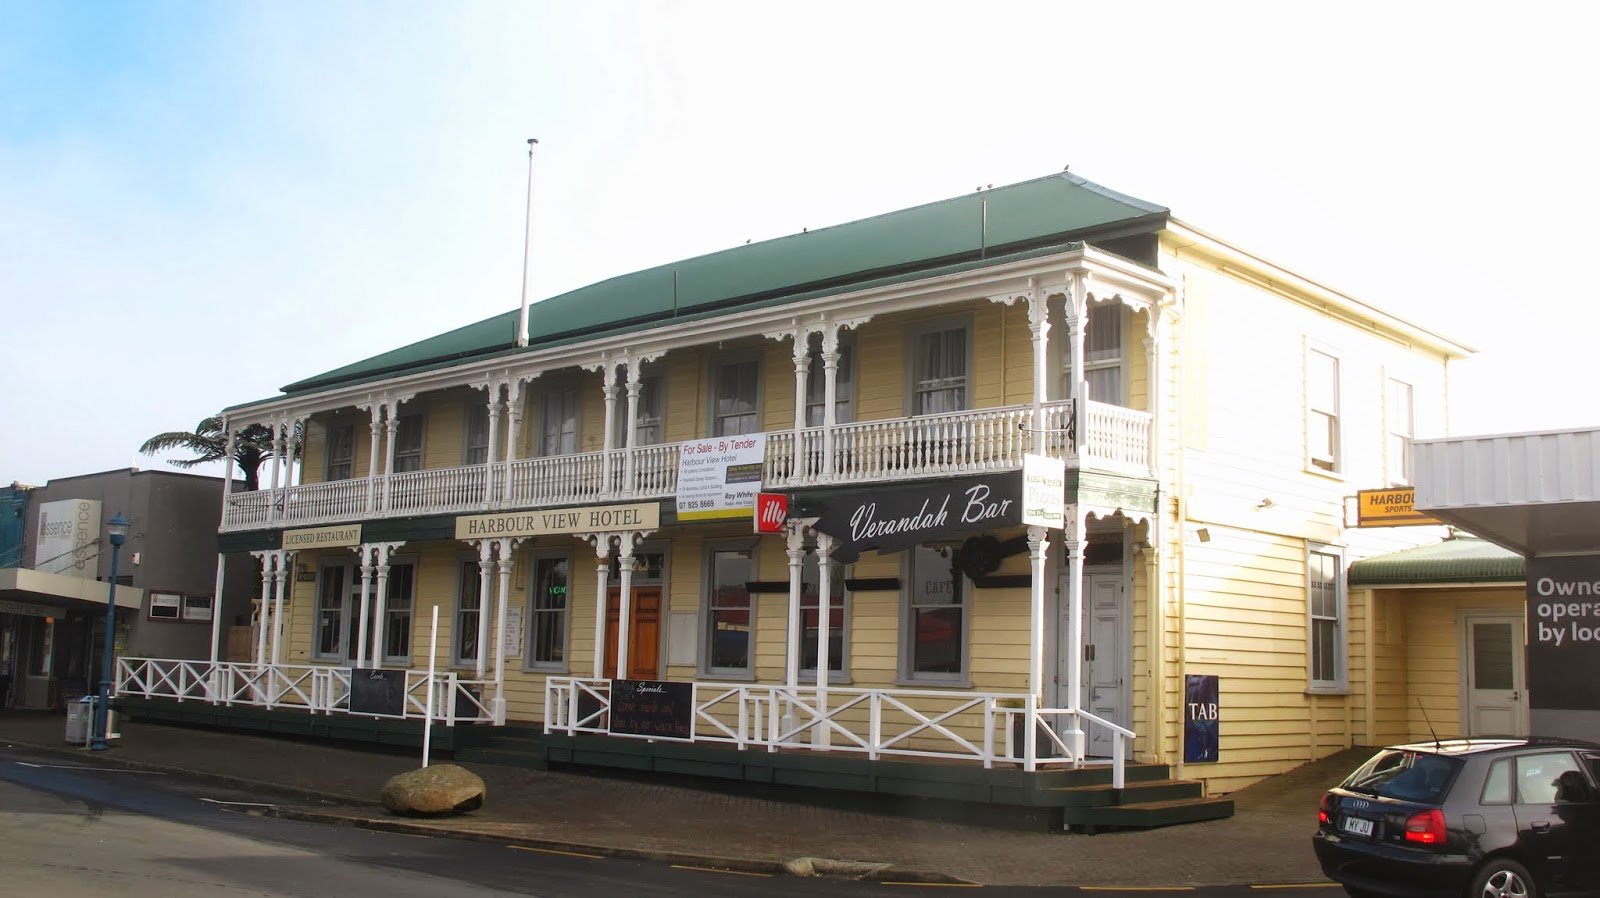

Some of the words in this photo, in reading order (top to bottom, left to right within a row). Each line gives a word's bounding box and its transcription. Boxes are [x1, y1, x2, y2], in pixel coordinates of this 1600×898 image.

[683, 445, 696, 455] For
[697, 443, 713, 454] Sale
[719, 441, 729, 453] By
[731, 438, 756, 450] Tender
[682, 457, 706, 466] Harbour
[706, 455, 720, 464] View
[721, 454, 737, 463] Hotel
[736, 491, 753, 499] White
[1028, 486, 1061, 505] Pizzas
[688, 501, 698, 509] 825
[850, 494, 950, 541] Verandah
[961, 484, 1012, 523] Bar
[1385, 505, 1412, 513] SPORTS
[468, 516, 535, 534] HARBOUR
[542, 512, 581, 529] VIEW
[589, 508, 642, 527] HOTEL
[762, 500, 787, 528] illy
[40, 521, 73, 536] essence
[75, 501, 90, 570] essence
[285, 533, 315, 545] LICENSED
[316, 529, 358, 542] RESTAURANT
[1537, 577, 1600, 596] Owne
[1537, 602, 1600, 622] opera
[1538, 621, 1566, 646] by
[637, 682, 667, 694] Specials
[1188, 703, 1217, 720] TAB
